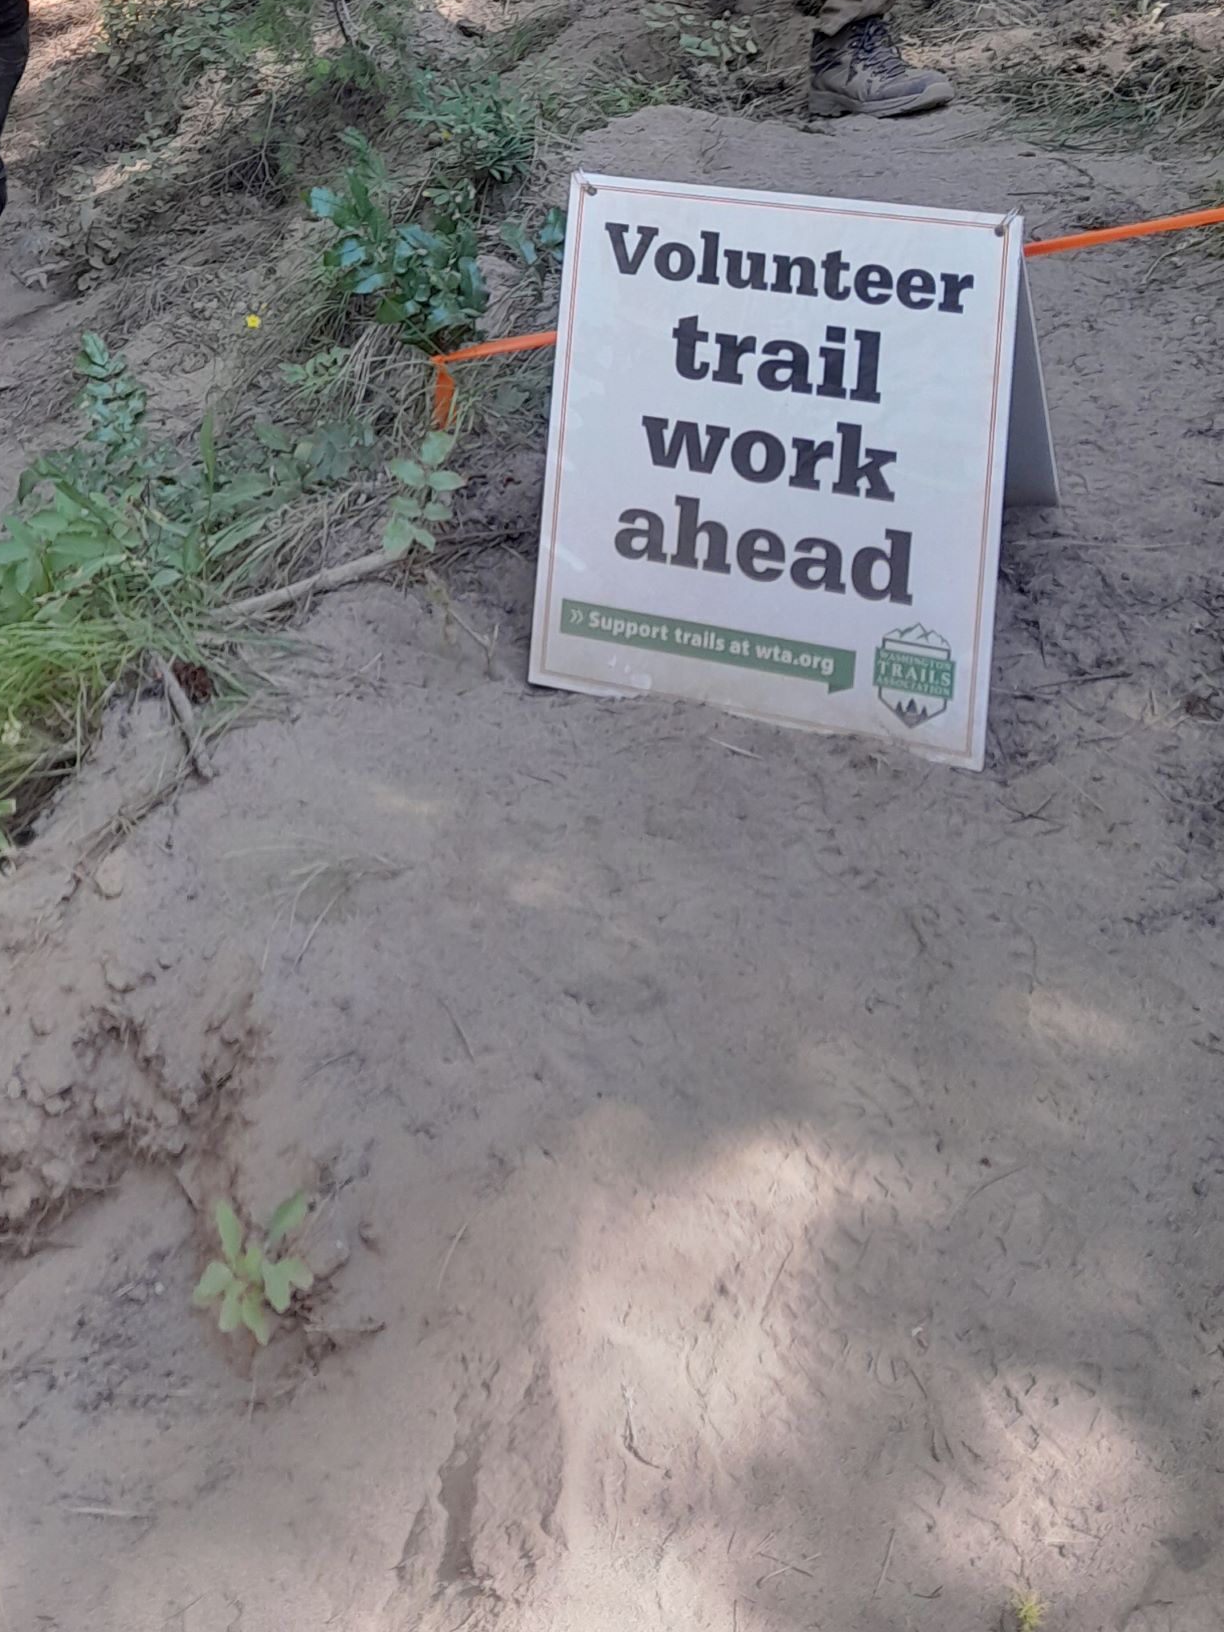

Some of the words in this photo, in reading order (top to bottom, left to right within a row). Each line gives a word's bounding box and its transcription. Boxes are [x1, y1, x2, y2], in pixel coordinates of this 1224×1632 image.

[605, 222, 974, 314] Volunteer
[672, 315, 881, 404] trail
[642, 415, 897, 502] work
[614, 495, 913, 606] ahead
[588, 610, 669, 641] Support
[674, 627, 726, 652] trails
[729, 638, 750, 657] at
[755, 643, 835, 676] wta.org
[878, 658, 952, 687] TRAILS
[879, 649, 953, 671] WASHINGTON
[876, 674, 951, 696] ASSOCIATION
